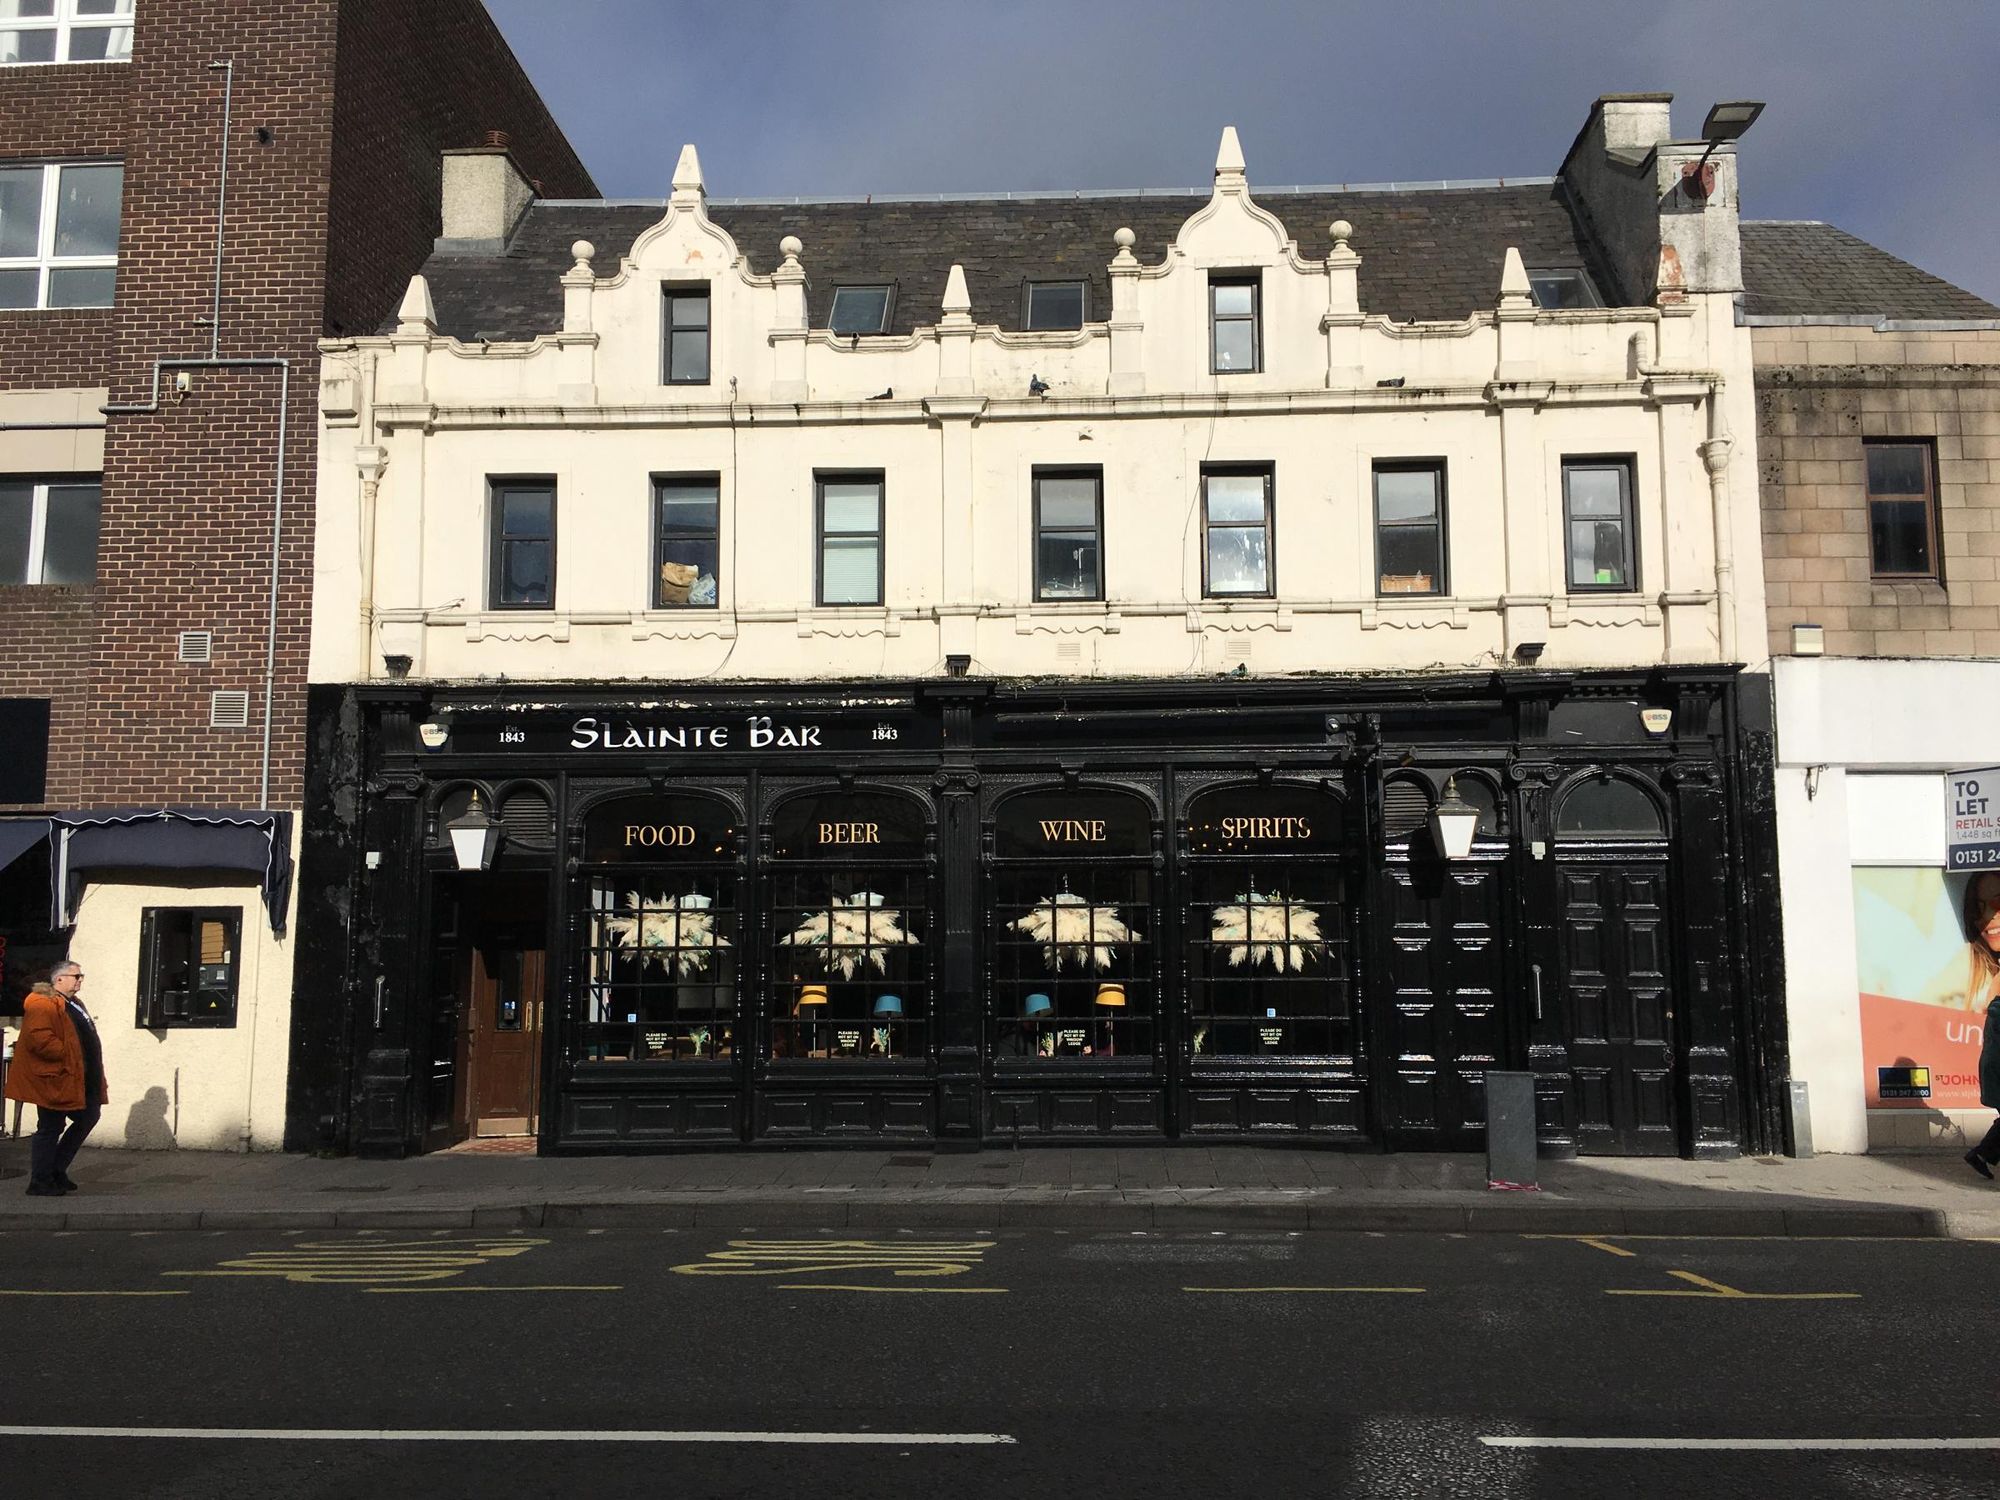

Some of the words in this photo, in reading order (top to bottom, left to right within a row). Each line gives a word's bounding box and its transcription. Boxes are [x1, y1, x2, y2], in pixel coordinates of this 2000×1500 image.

[499, 731, 525, 743] 1843
[871, 729, 899, 740] 1843
[1955, 780, 1980, 797] TO
[1956, 798, 1989, 816] LET
[1039, 820, 1106, 841] WINE
[1222, 817, 1311, 838] SPIRITS
[1955, 817, 1994, 830] RETAIL
[624, 826, 696, 846] FOOD
[818, 823, 880, 844] BEER
[1956, 829, 1979, 840] 1,448
[1955, 850, 1983, 864] 0131
[160, 1238, 551, 1283] STOP
[669, 1240, 997, 1276] BUS
